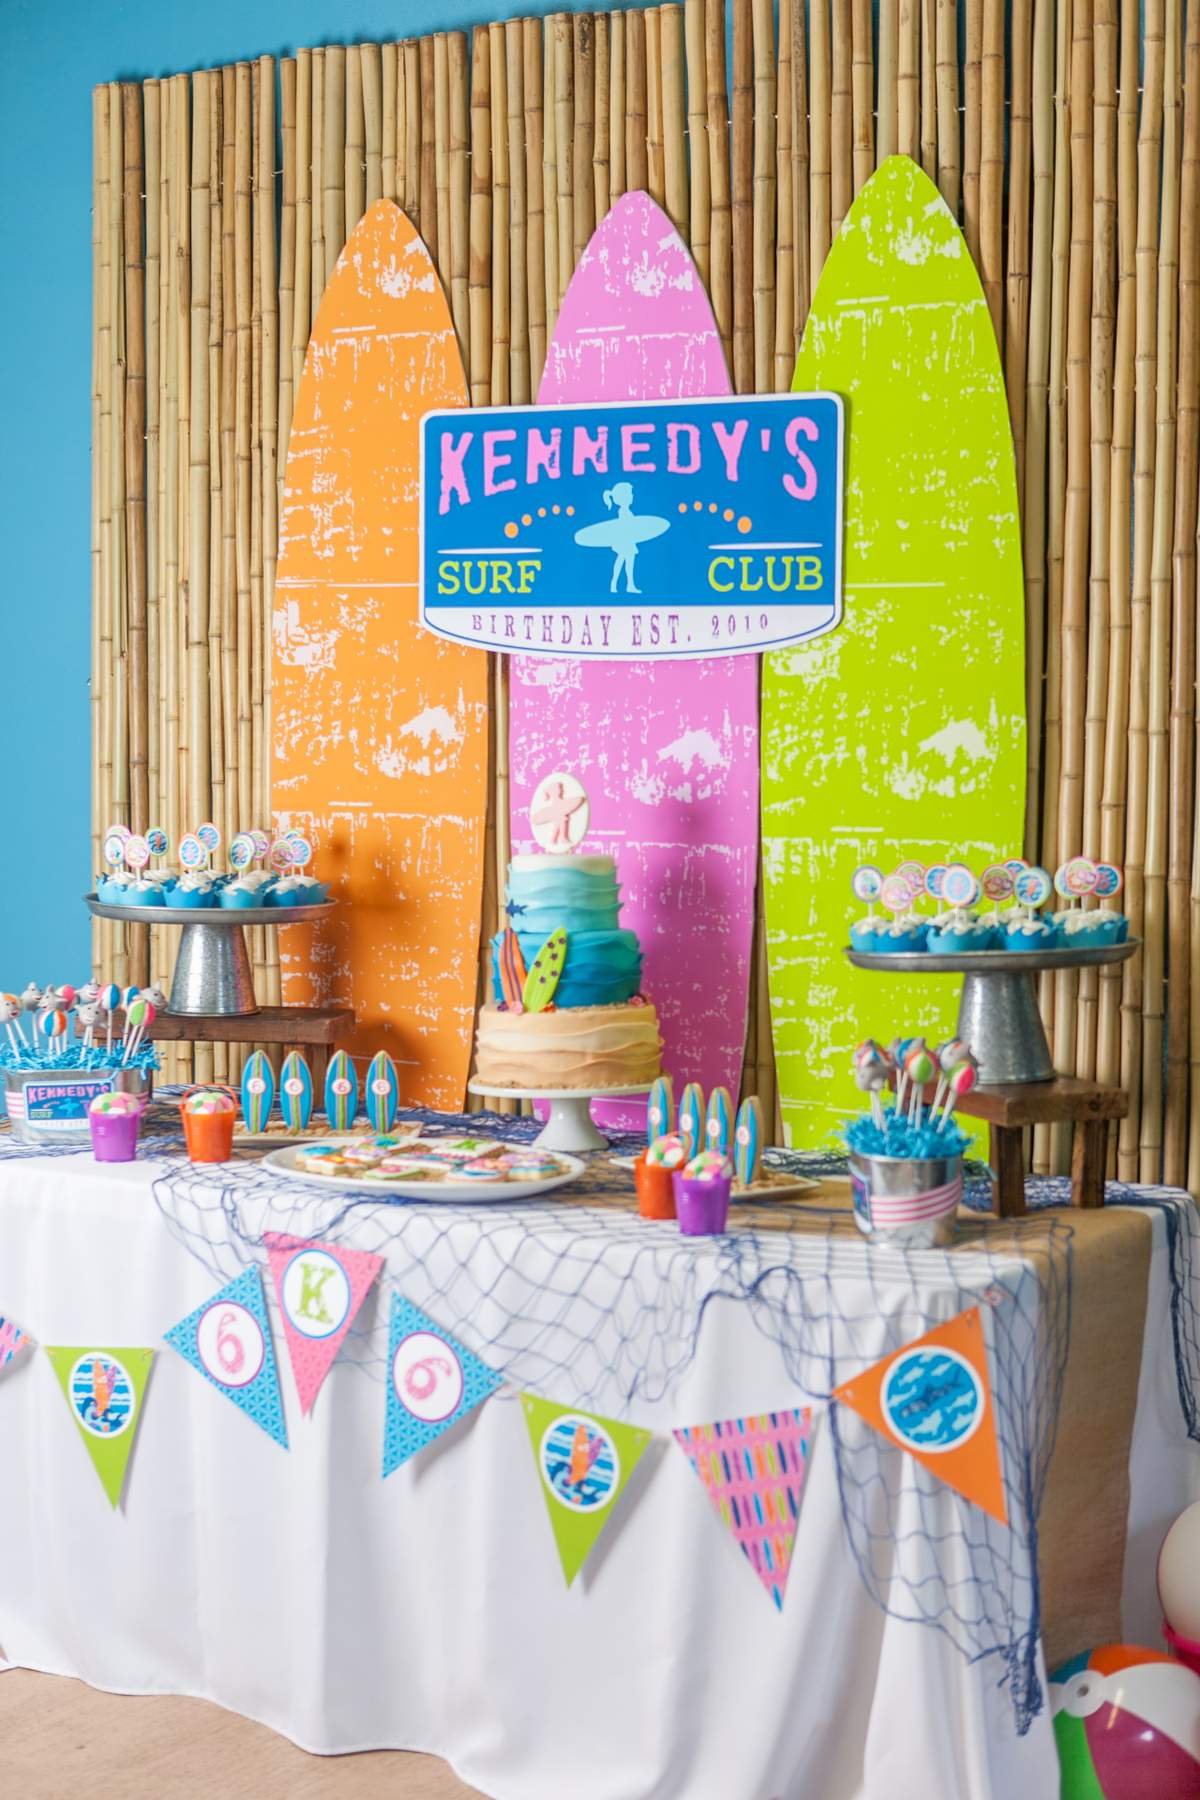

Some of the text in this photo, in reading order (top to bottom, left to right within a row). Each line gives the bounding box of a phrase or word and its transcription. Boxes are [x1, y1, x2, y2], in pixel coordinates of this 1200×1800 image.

[438, 416, 820, 516] KENNEDY'S
[437, 556, 823, 595] SURF CLUB
[471, 613, 769, 647] BIRTHDAY EST. 2010
[296, 1262, 336, 1325] K
[215, 1311, 246, 1375] 6
[405, 1355, 453, 1401] 6
